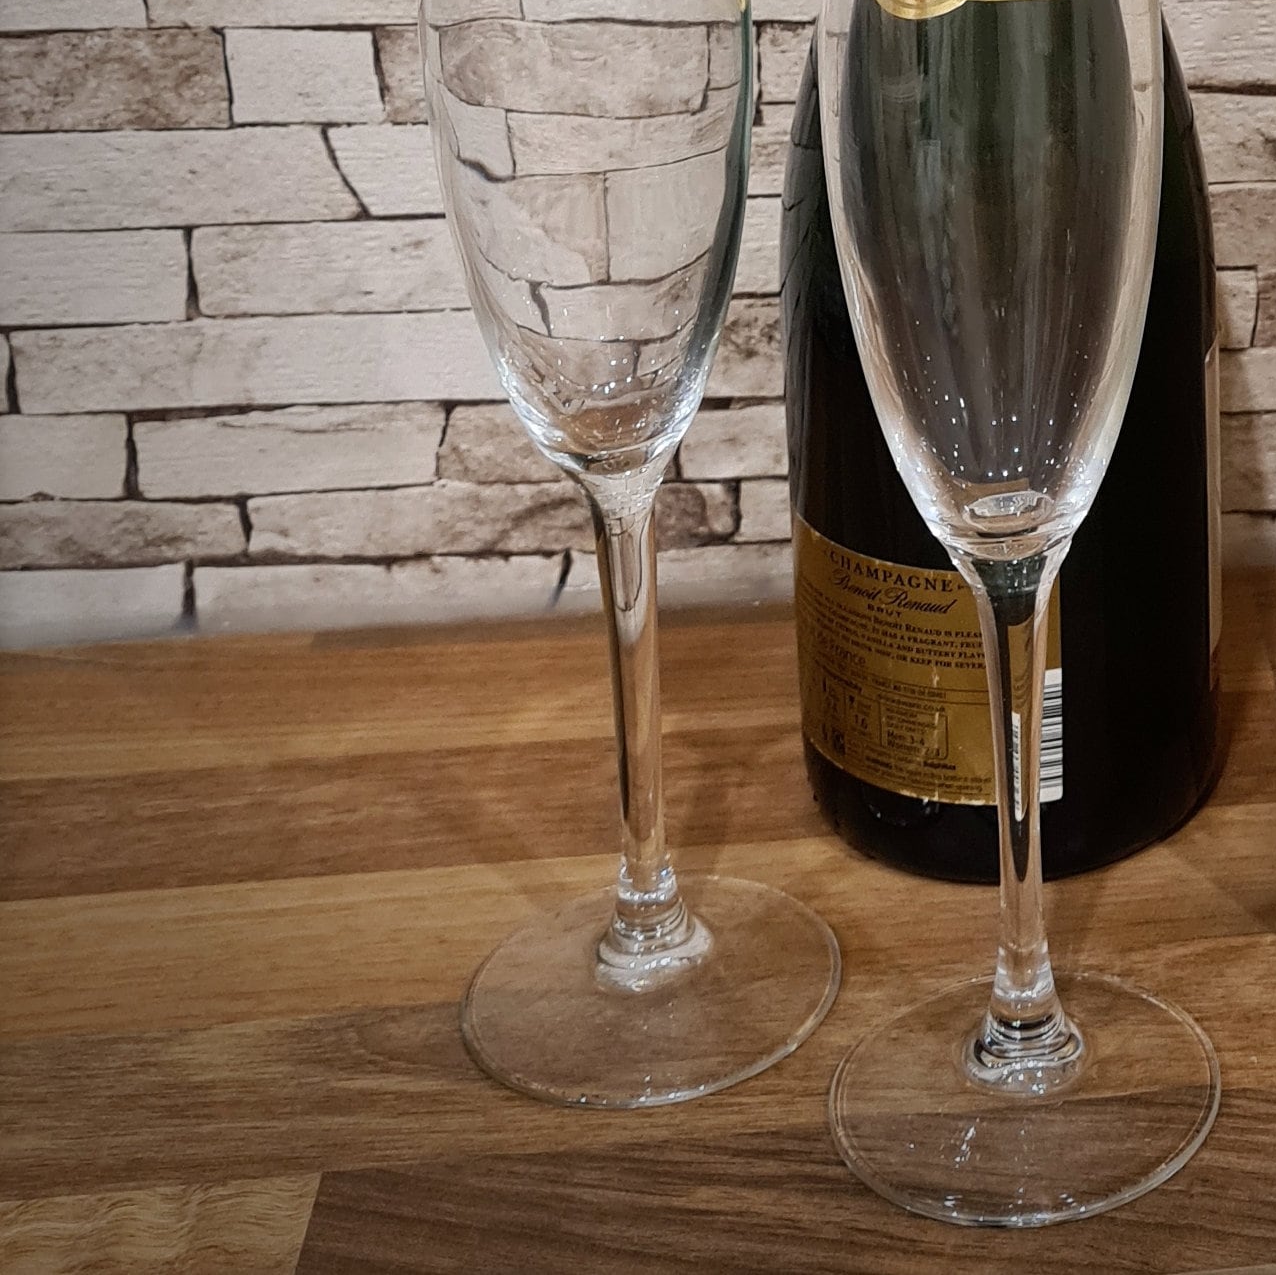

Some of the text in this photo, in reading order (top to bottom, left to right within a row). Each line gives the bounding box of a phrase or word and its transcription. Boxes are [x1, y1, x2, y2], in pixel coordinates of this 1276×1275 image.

[829, 550, 954, 593] CHAMPAGNE
[867, 603, 902, 619] BRUT
[881, 586, 958, 615] Renaud
